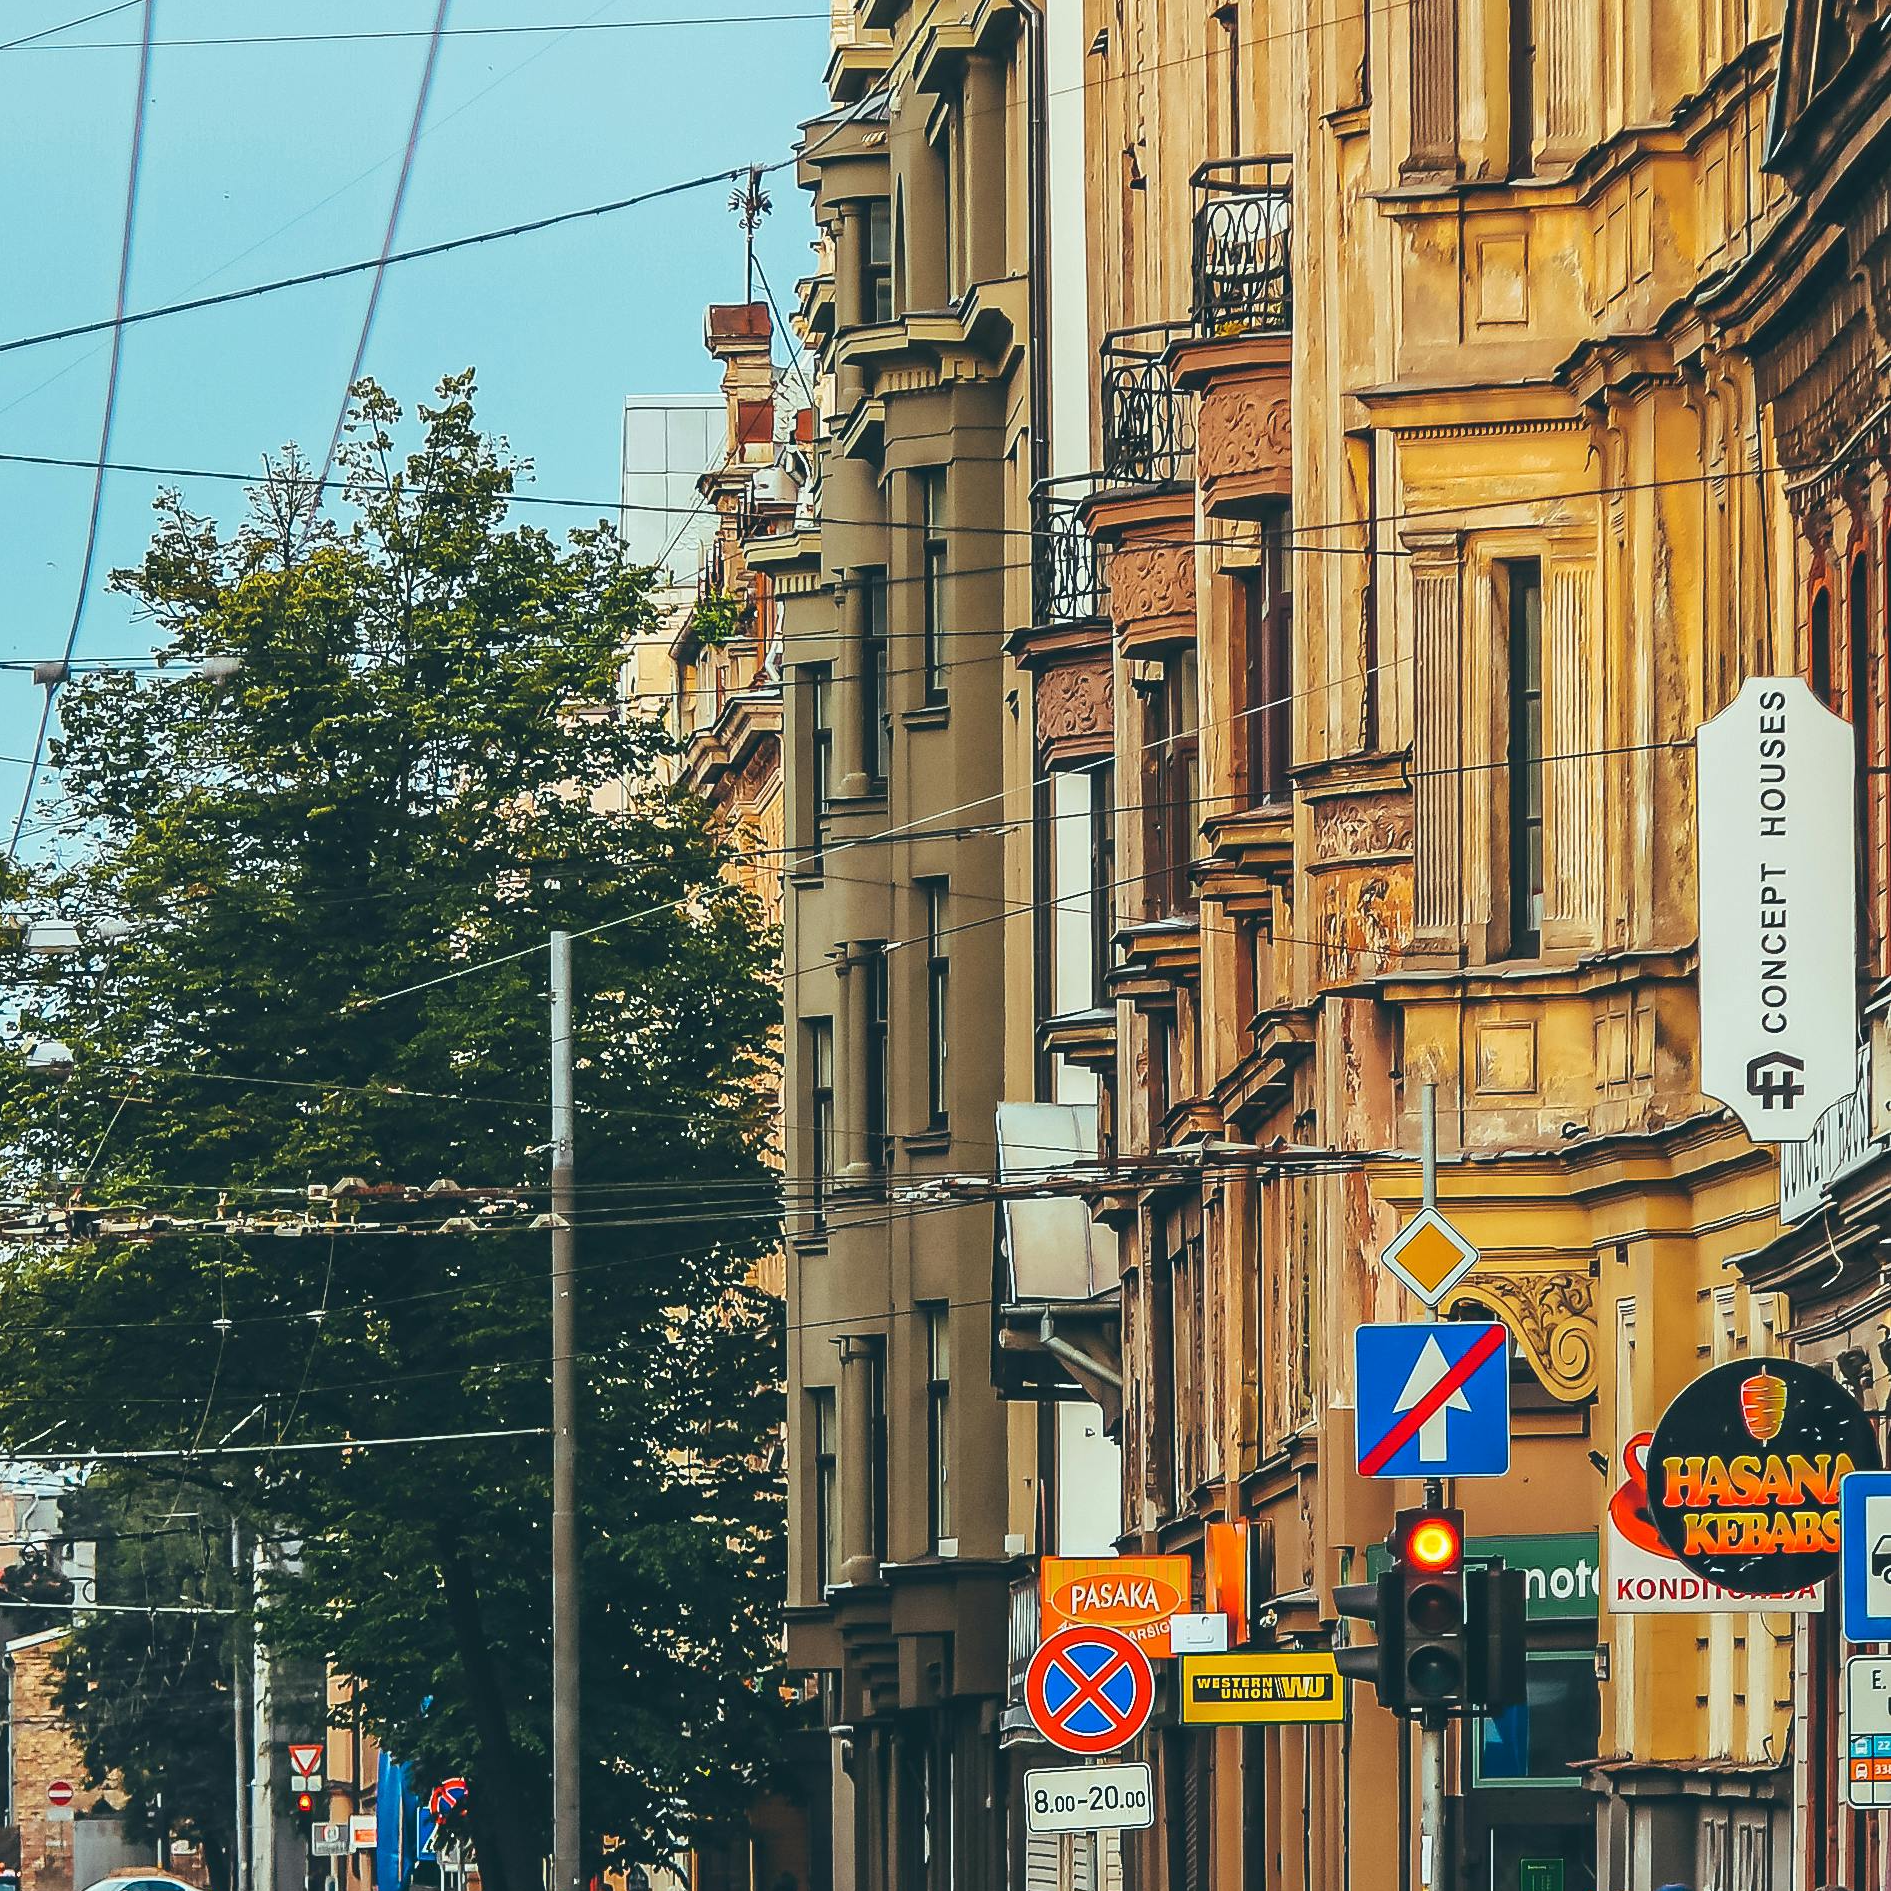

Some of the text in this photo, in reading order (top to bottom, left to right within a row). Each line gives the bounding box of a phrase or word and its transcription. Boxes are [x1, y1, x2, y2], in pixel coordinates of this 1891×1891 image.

[1759, 690, 1788, 1034] CONCEPT HOUSES
[1683, 1511, 1840, 1555] KEBABS
[1071, 1579, 1160, 1615] PASAKA
[1197, 1677, 1272, 1689] WESTERN
[1221, 1688, 1273, 1699] UNION
[1280, 1676, 1325, 1698] WU
[1034, 1785, 1146, 1814] 8.00-20.00
